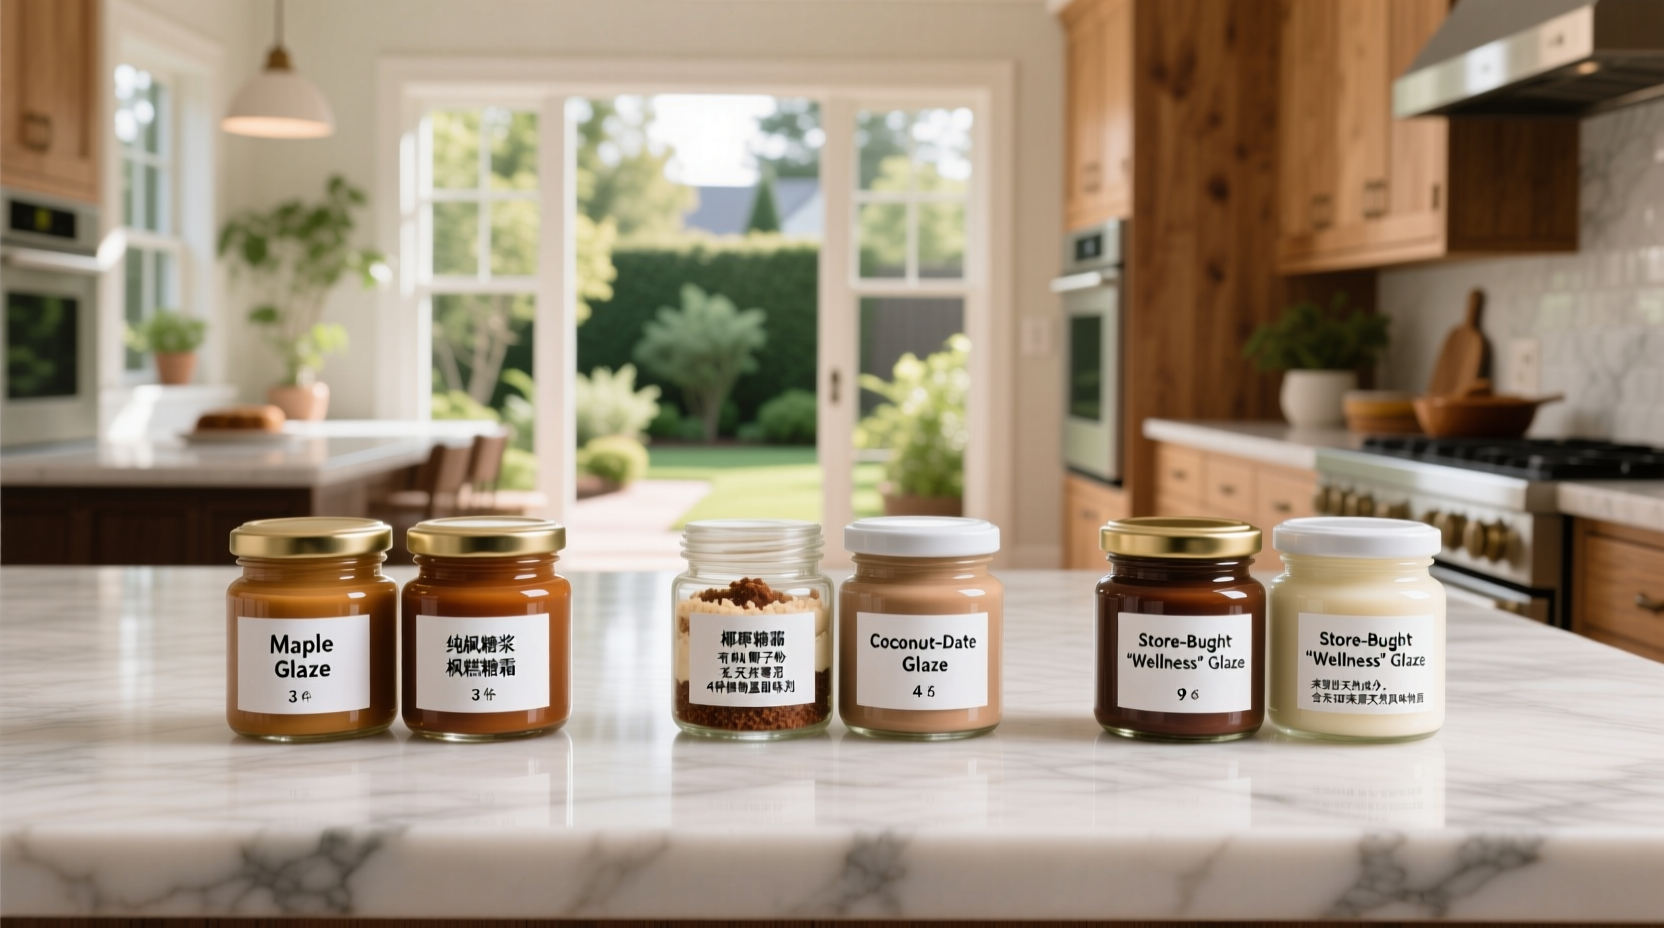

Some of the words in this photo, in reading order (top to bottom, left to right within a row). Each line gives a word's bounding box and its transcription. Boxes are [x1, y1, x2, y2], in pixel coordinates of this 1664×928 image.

[270, 633, 334, 658] Maple
[870, 633, 977, 650] Coconut-Date
[1138, 633, 1233, 653] Store-Bught
[1319, 631, 1413, 651] Store-Bught
[902, 656, 948, 672] Glaze
[1208, 655, 1245, 670] Glaze
[1391, 652, 1426, 667] Glaze
[275, 659, 331, 678] Glaze
[288, 690, 297, 703] 3
[912, 685, 922, 698] 4
[1177, 688, 1187, 701] 9
